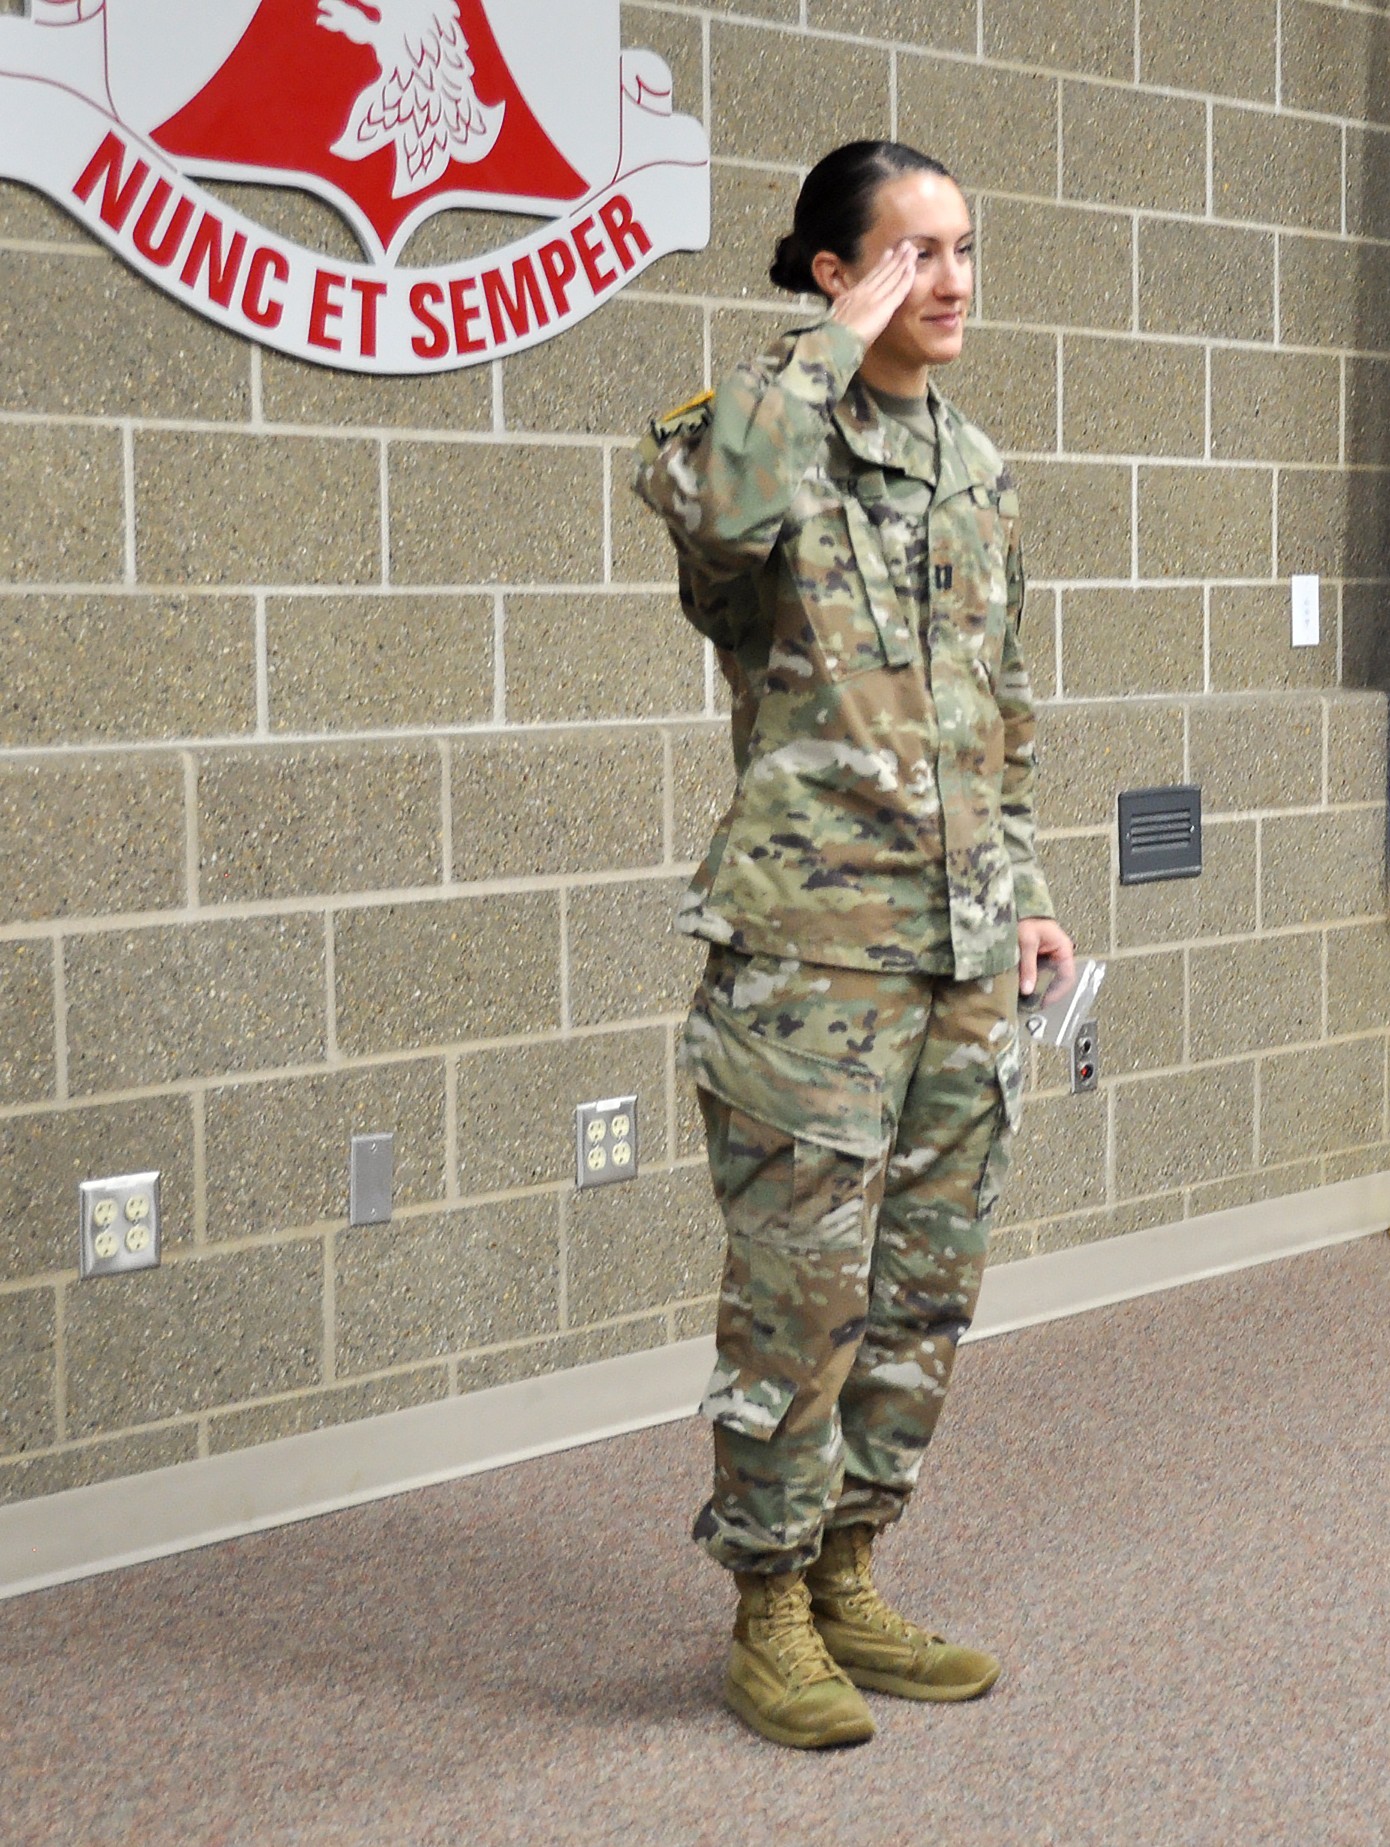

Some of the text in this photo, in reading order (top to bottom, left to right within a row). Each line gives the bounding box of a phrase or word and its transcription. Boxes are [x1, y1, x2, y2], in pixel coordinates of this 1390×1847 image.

[71, 131, 655, 361] NUNC ET SEMPER
